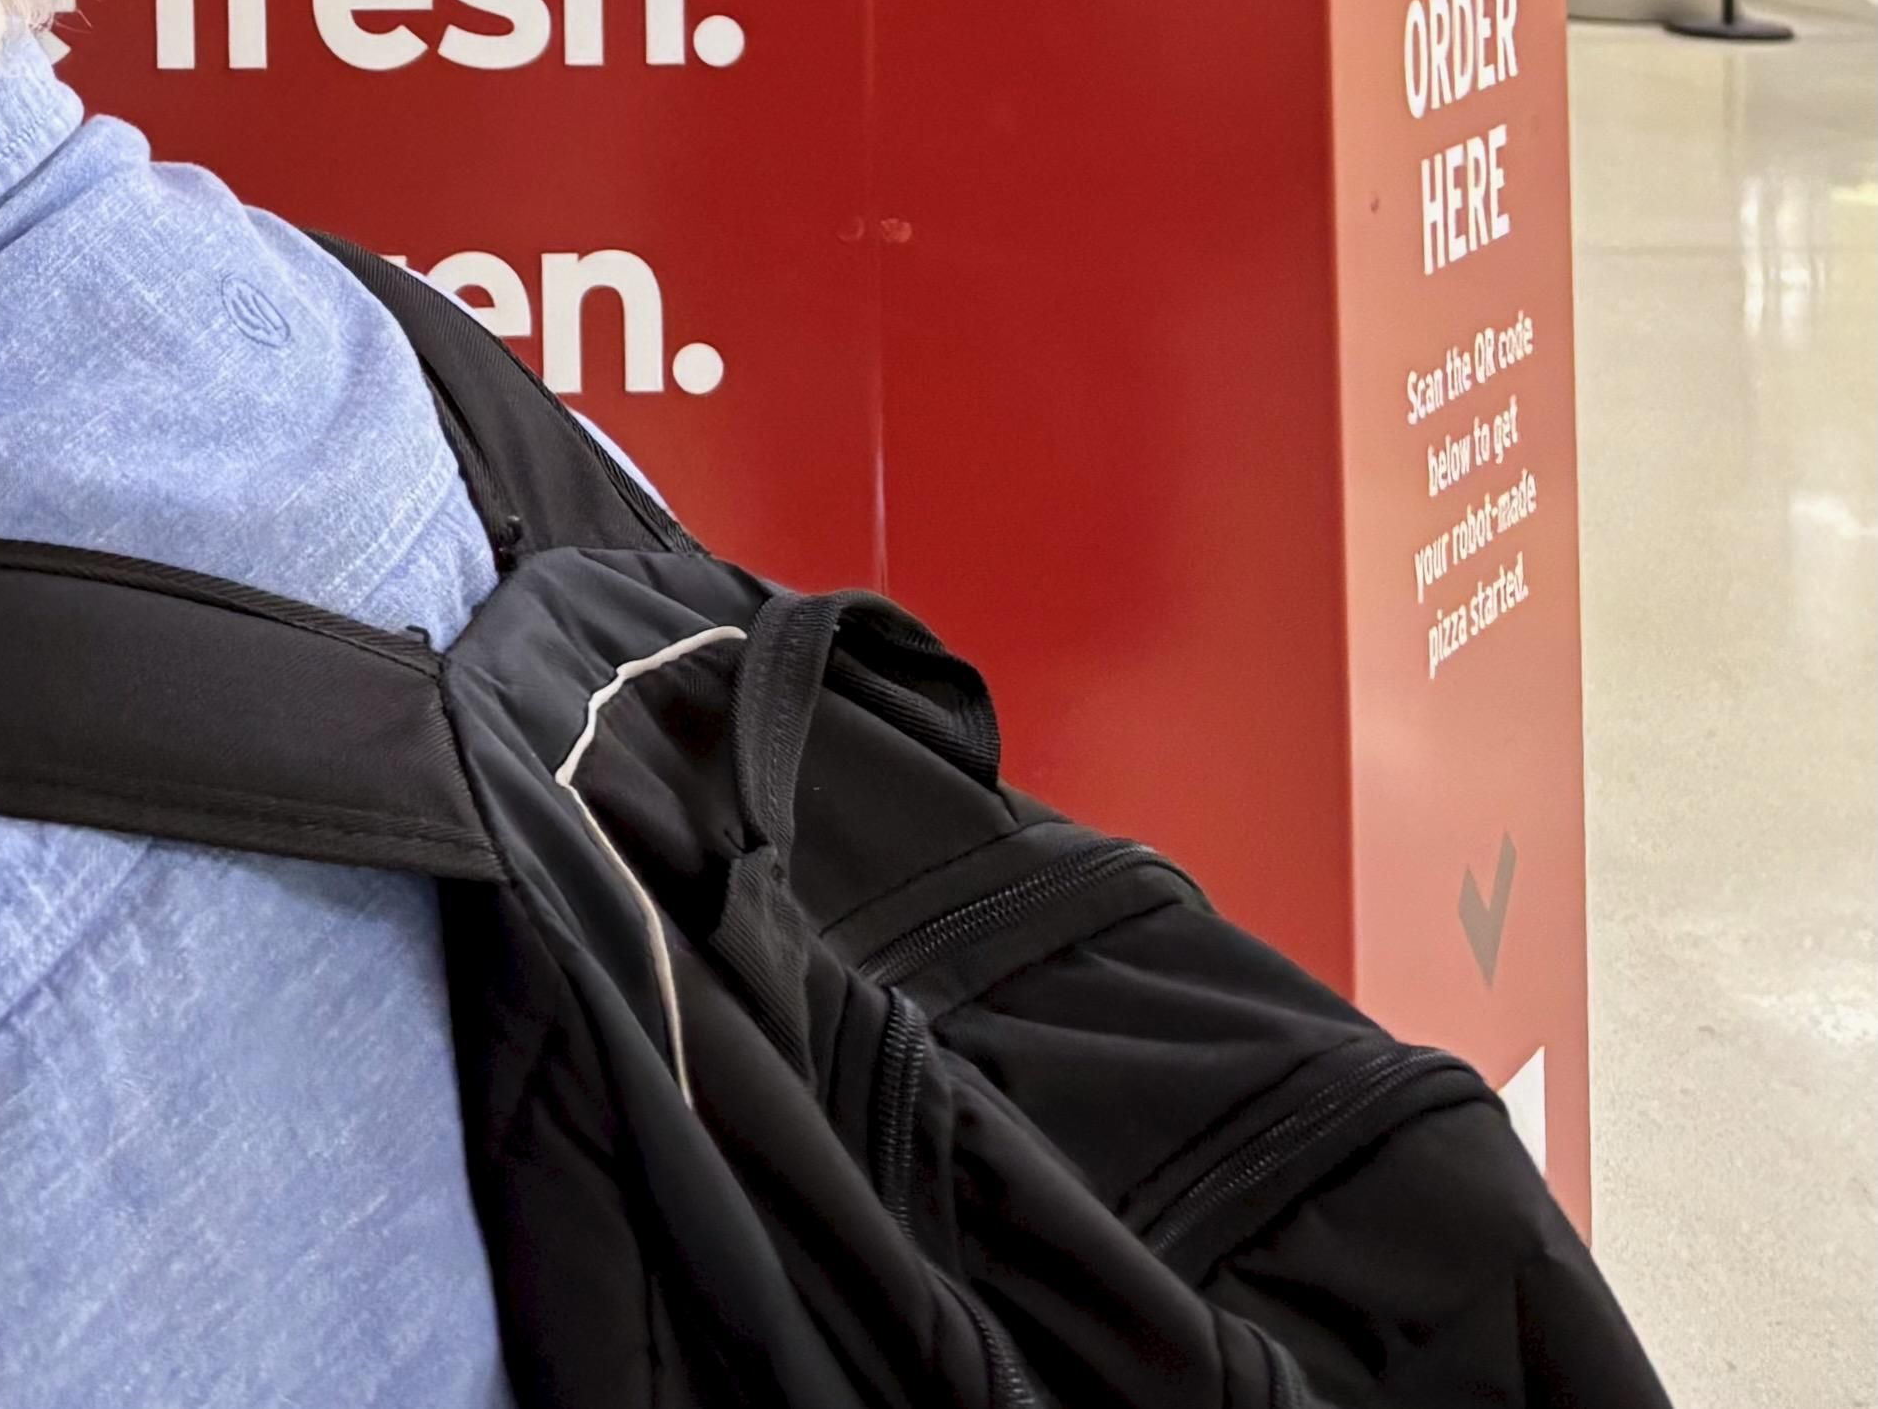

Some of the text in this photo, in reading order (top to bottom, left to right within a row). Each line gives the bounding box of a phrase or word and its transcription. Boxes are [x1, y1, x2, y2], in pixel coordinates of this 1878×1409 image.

[1420, 124, 1511, 276] HERE
[1406, 309, 1534, 425] Scan the QR code
[1426, 393, 1519, 498] below to get
[1414, 467, 1538, 605] your robot-made
[1427, 550, 1530, 681] pizza started.
